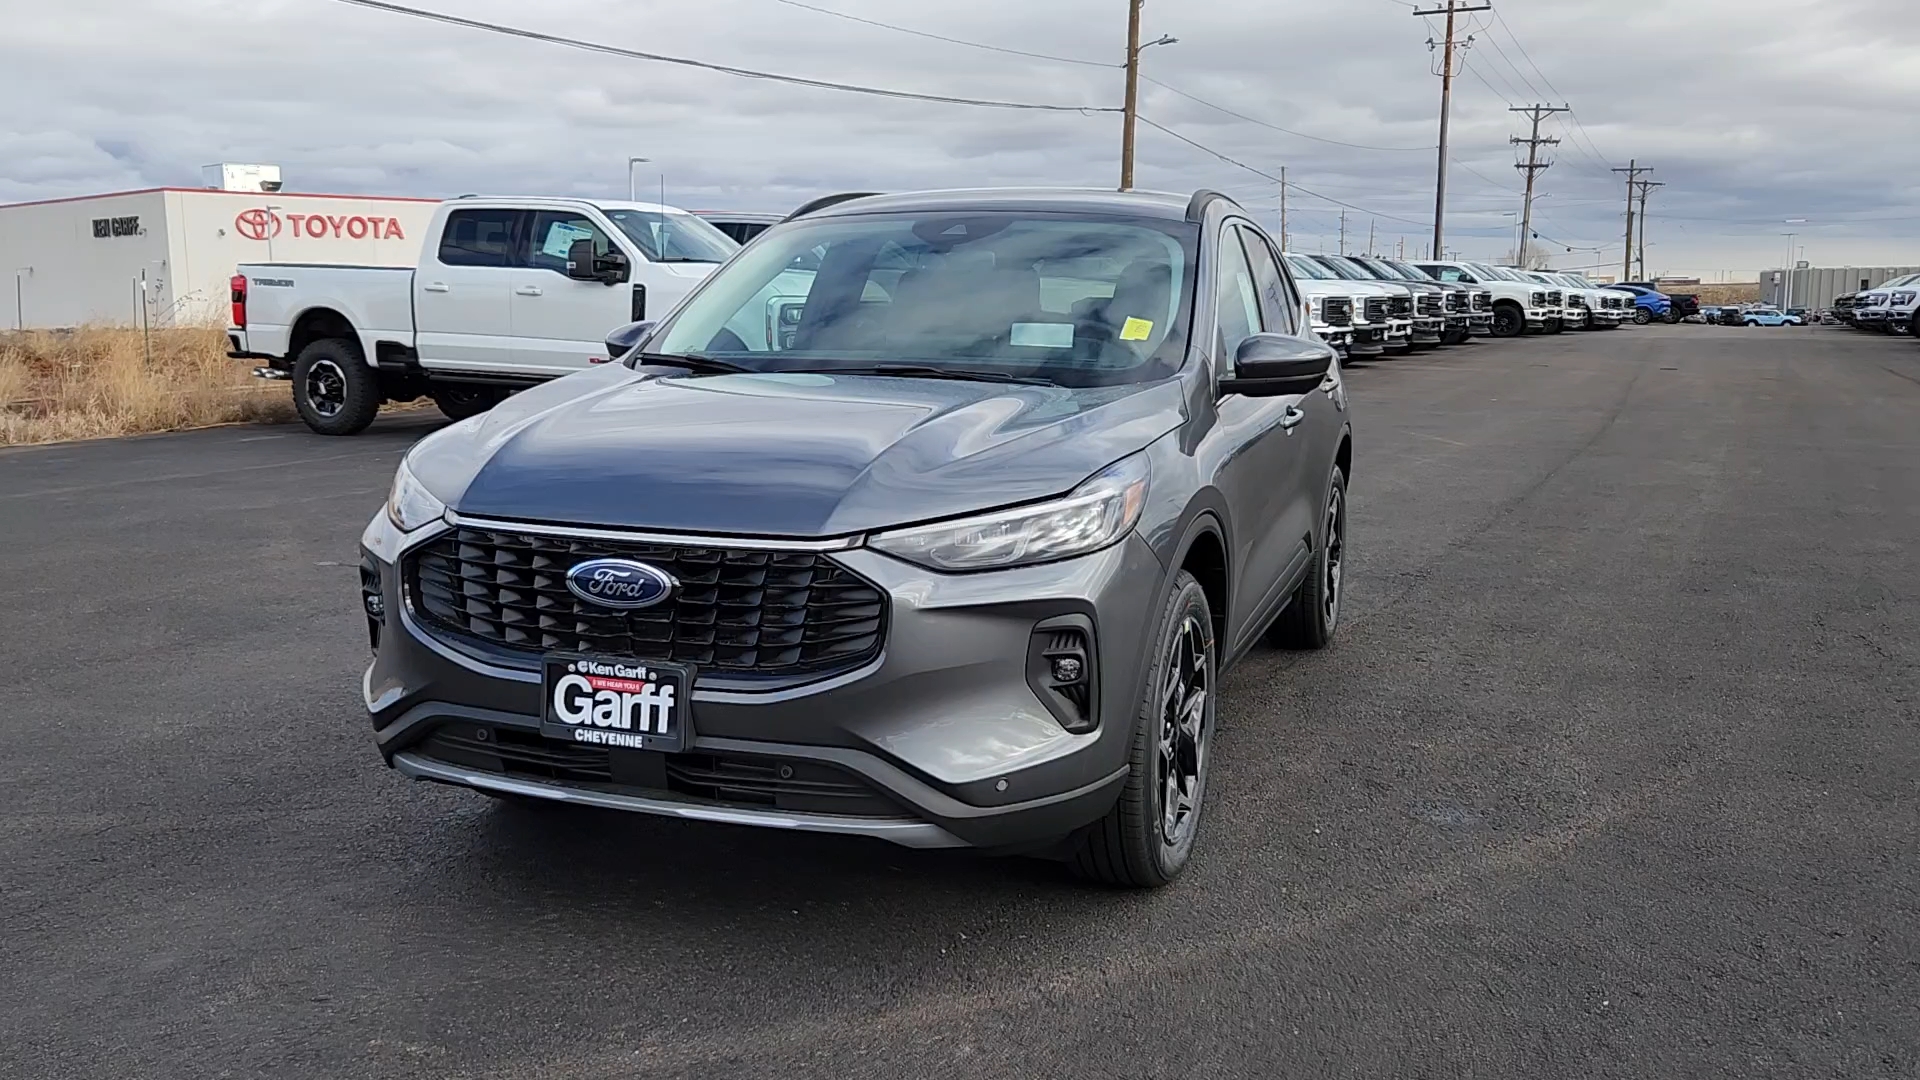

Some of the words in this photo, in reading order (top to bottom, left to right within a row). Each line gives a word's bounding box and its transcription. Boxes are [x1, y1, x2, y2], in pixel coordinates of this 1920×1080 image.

[287, 214, 405, 240] TOYOTA
[588, 568, 644, 597] Ford
[588, 661, 614, 676] Ken
[614, 664, 647, 679] Garff
[607, 681, 623, 689] HEAR
[553, 674, 674, 733] Garff
[574, 729, 643, 748] CHEYENNE
